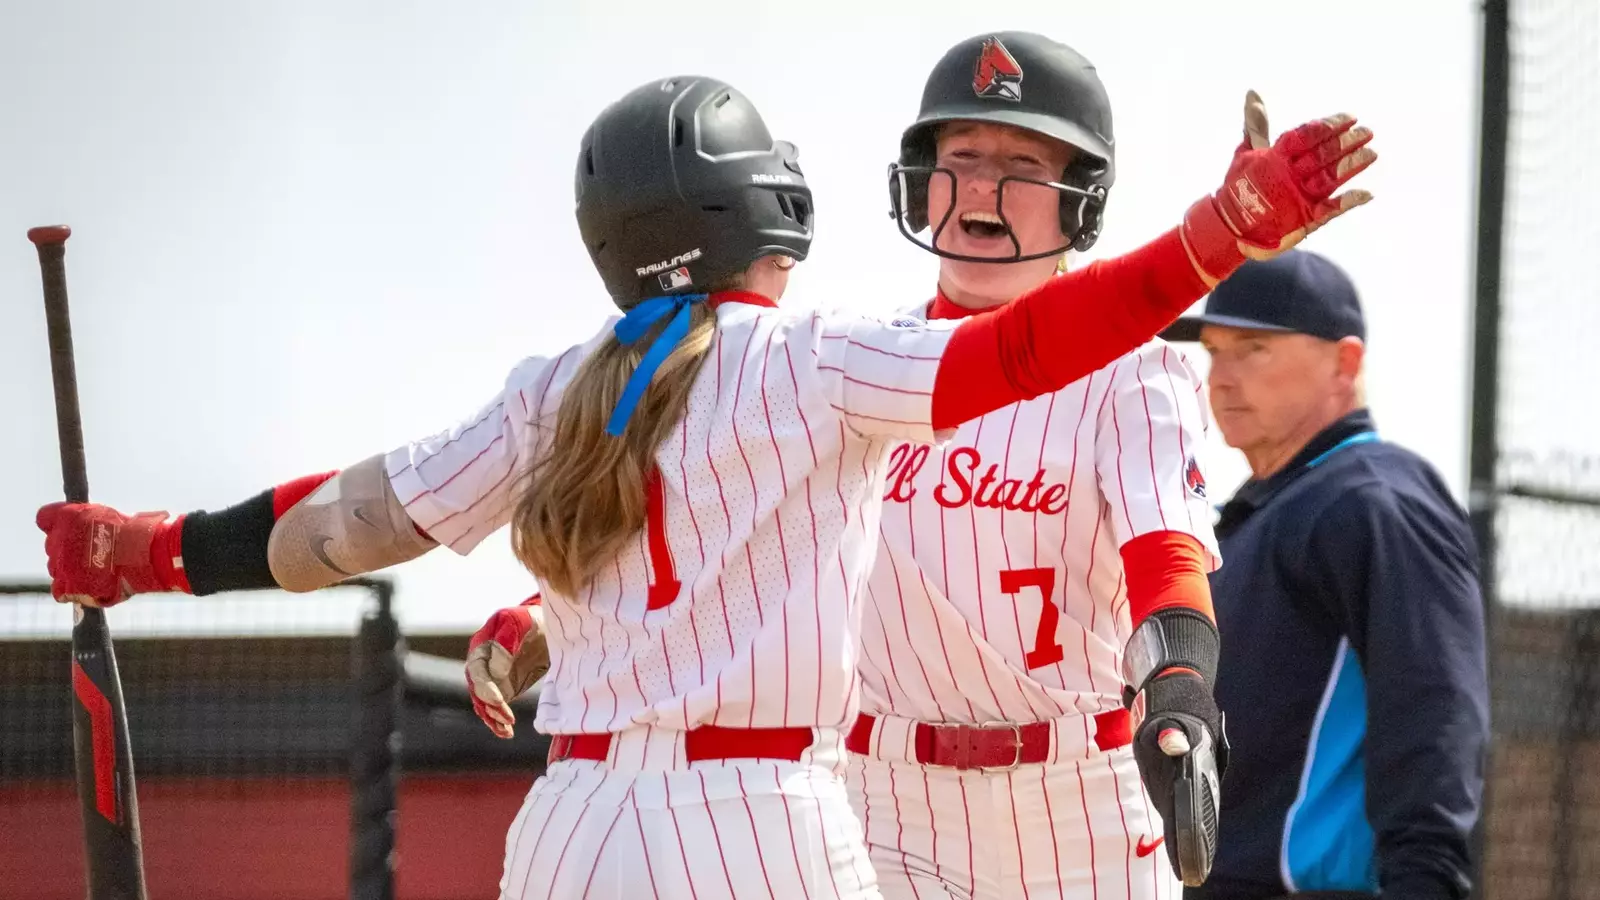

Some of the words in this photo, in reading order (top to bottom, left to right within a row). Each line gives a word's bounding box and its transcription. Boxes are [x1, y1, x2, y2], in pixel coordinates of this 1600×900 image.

[636, 248, 702, 277] RAWLINGS
[933, 447, 1069, 515] State
[999, 567, 1064, 671] 7
